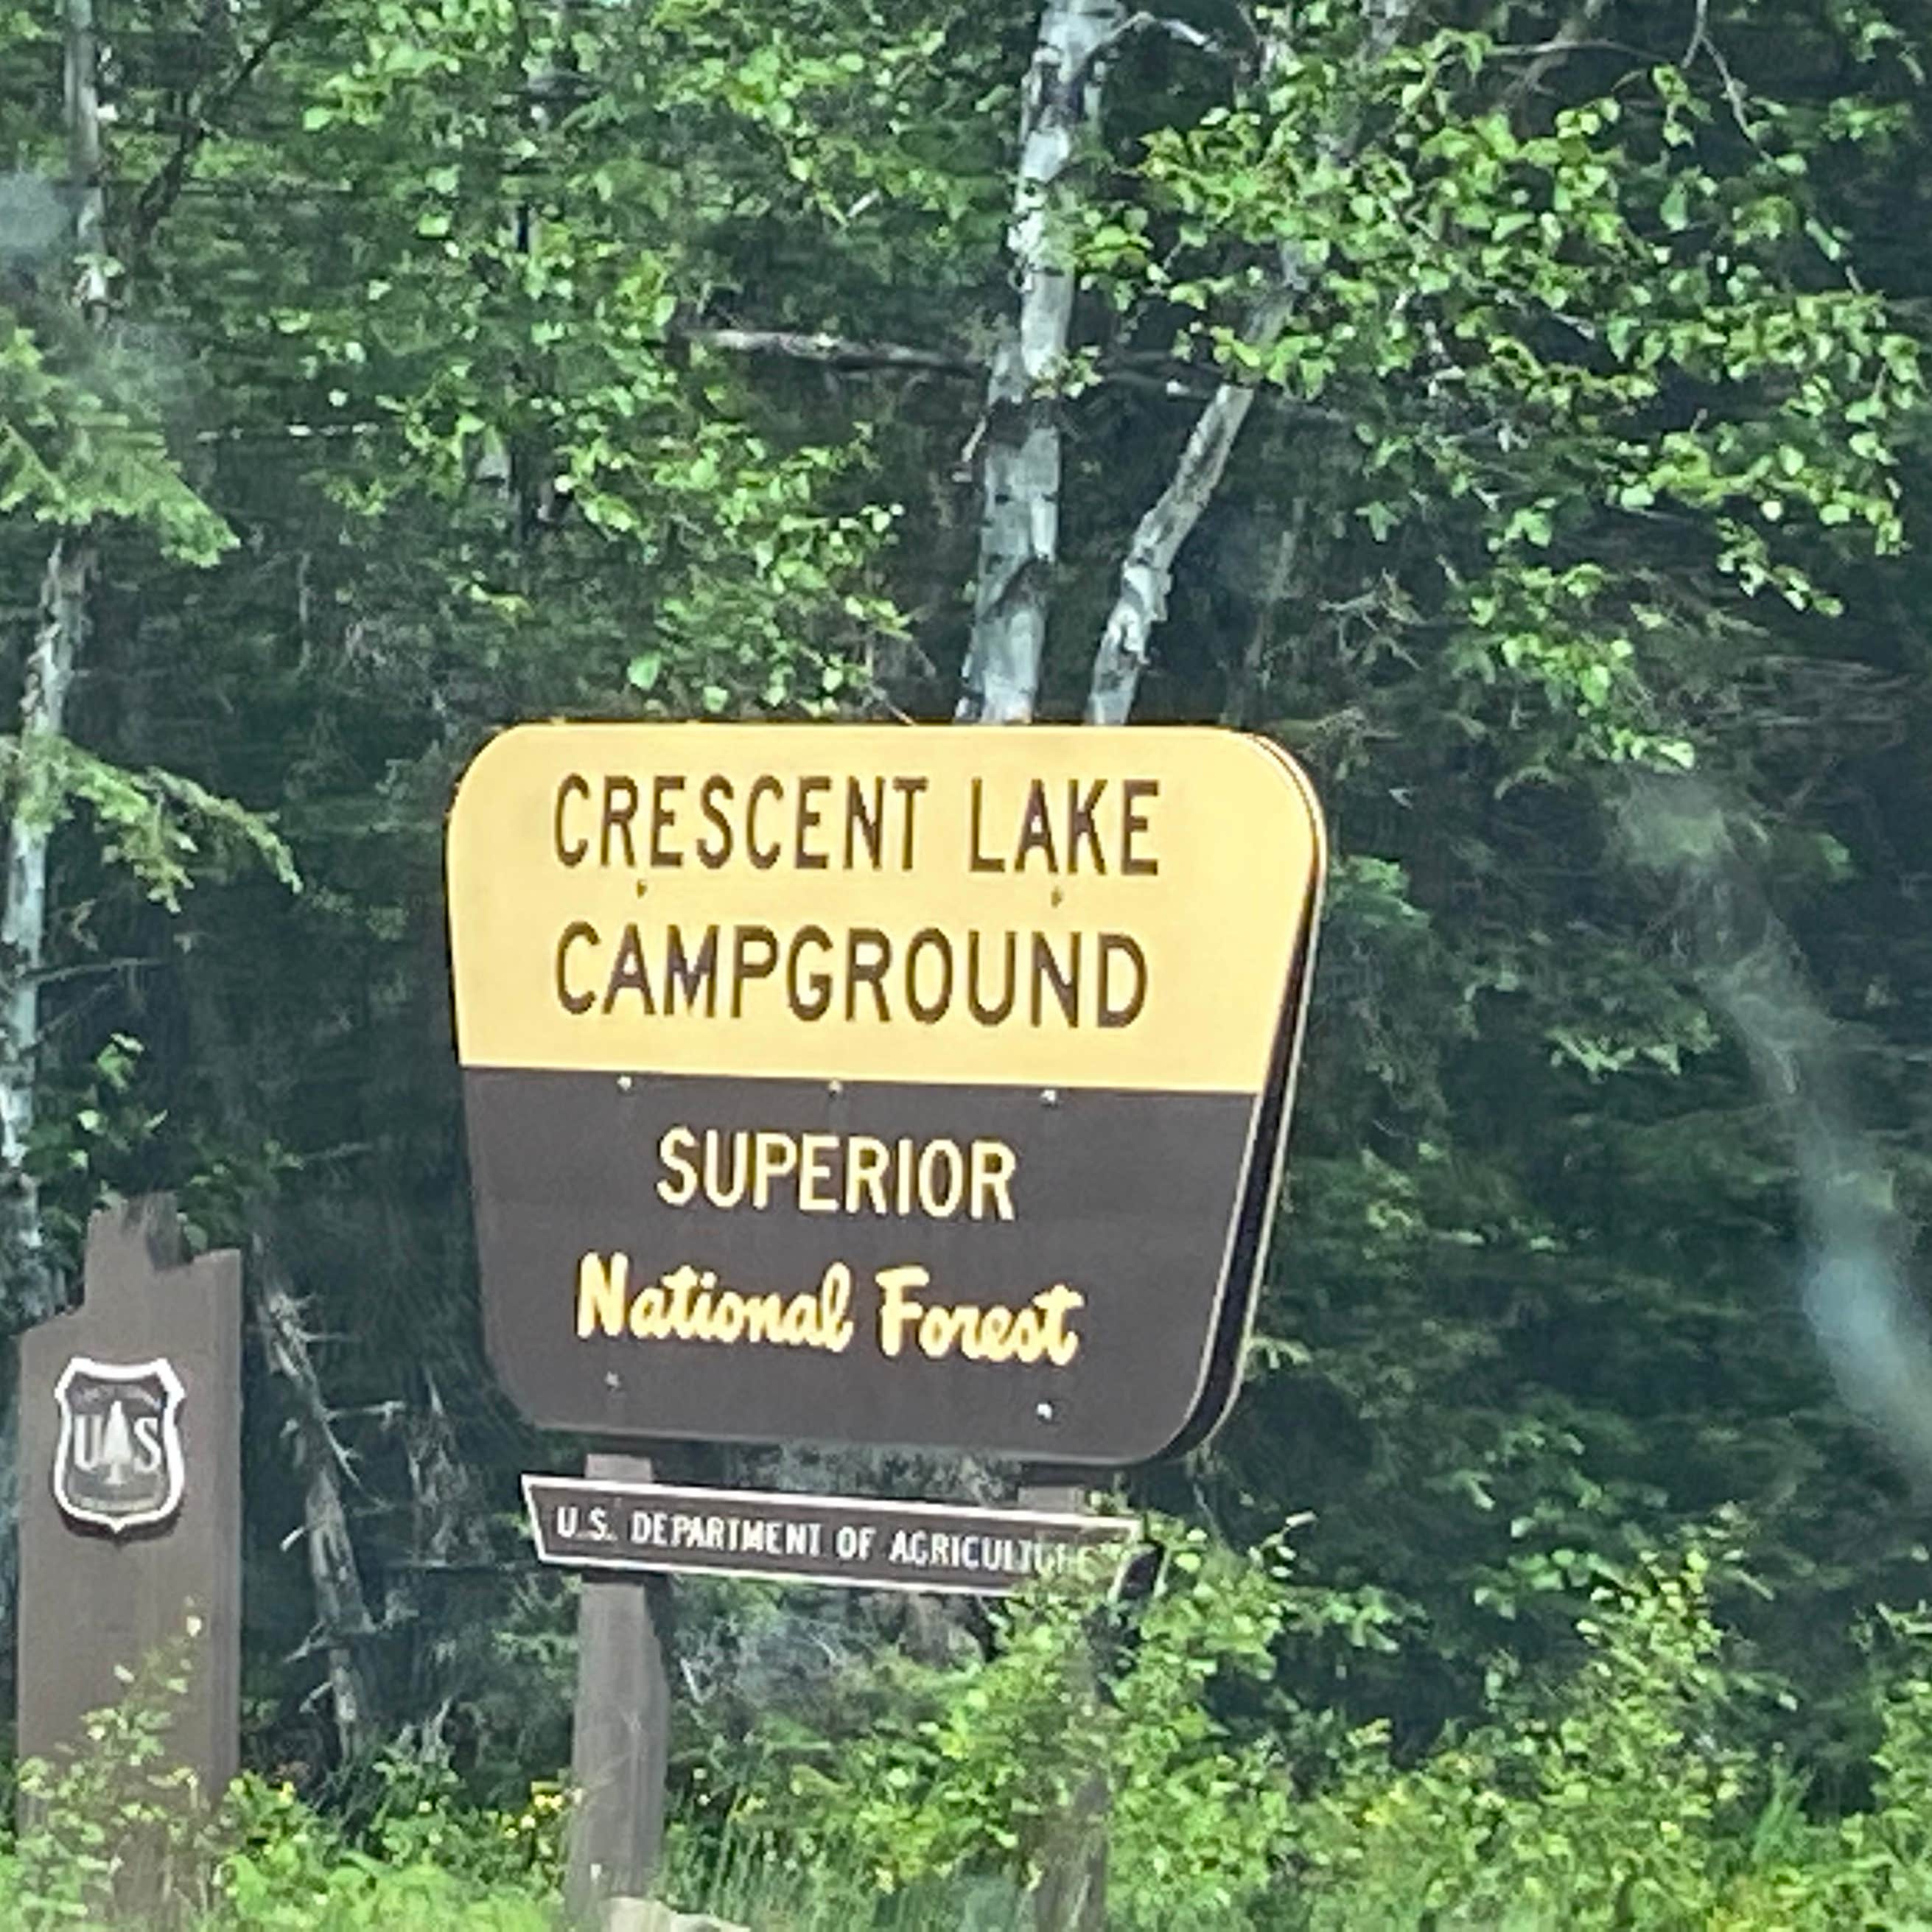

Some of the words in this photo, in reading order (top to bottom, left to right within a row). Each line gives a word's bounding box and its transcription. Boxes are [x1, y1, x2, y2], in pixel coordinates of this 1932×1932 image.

[554, 773, 928, 869] CRESCENT
[969, 778, 1159, 876] LAKE
[556, 921, 1147, 1029] CAMPGROUND
[657, 1126, 1016, 1220] SUPERIOR
[577, 1252, 853, 1352] National
[876, 1265, 1084, 1365] Forest
[630, 1509, 821, 1557] DEPARTMENT
[836, 1526, 876, 1561] OF
